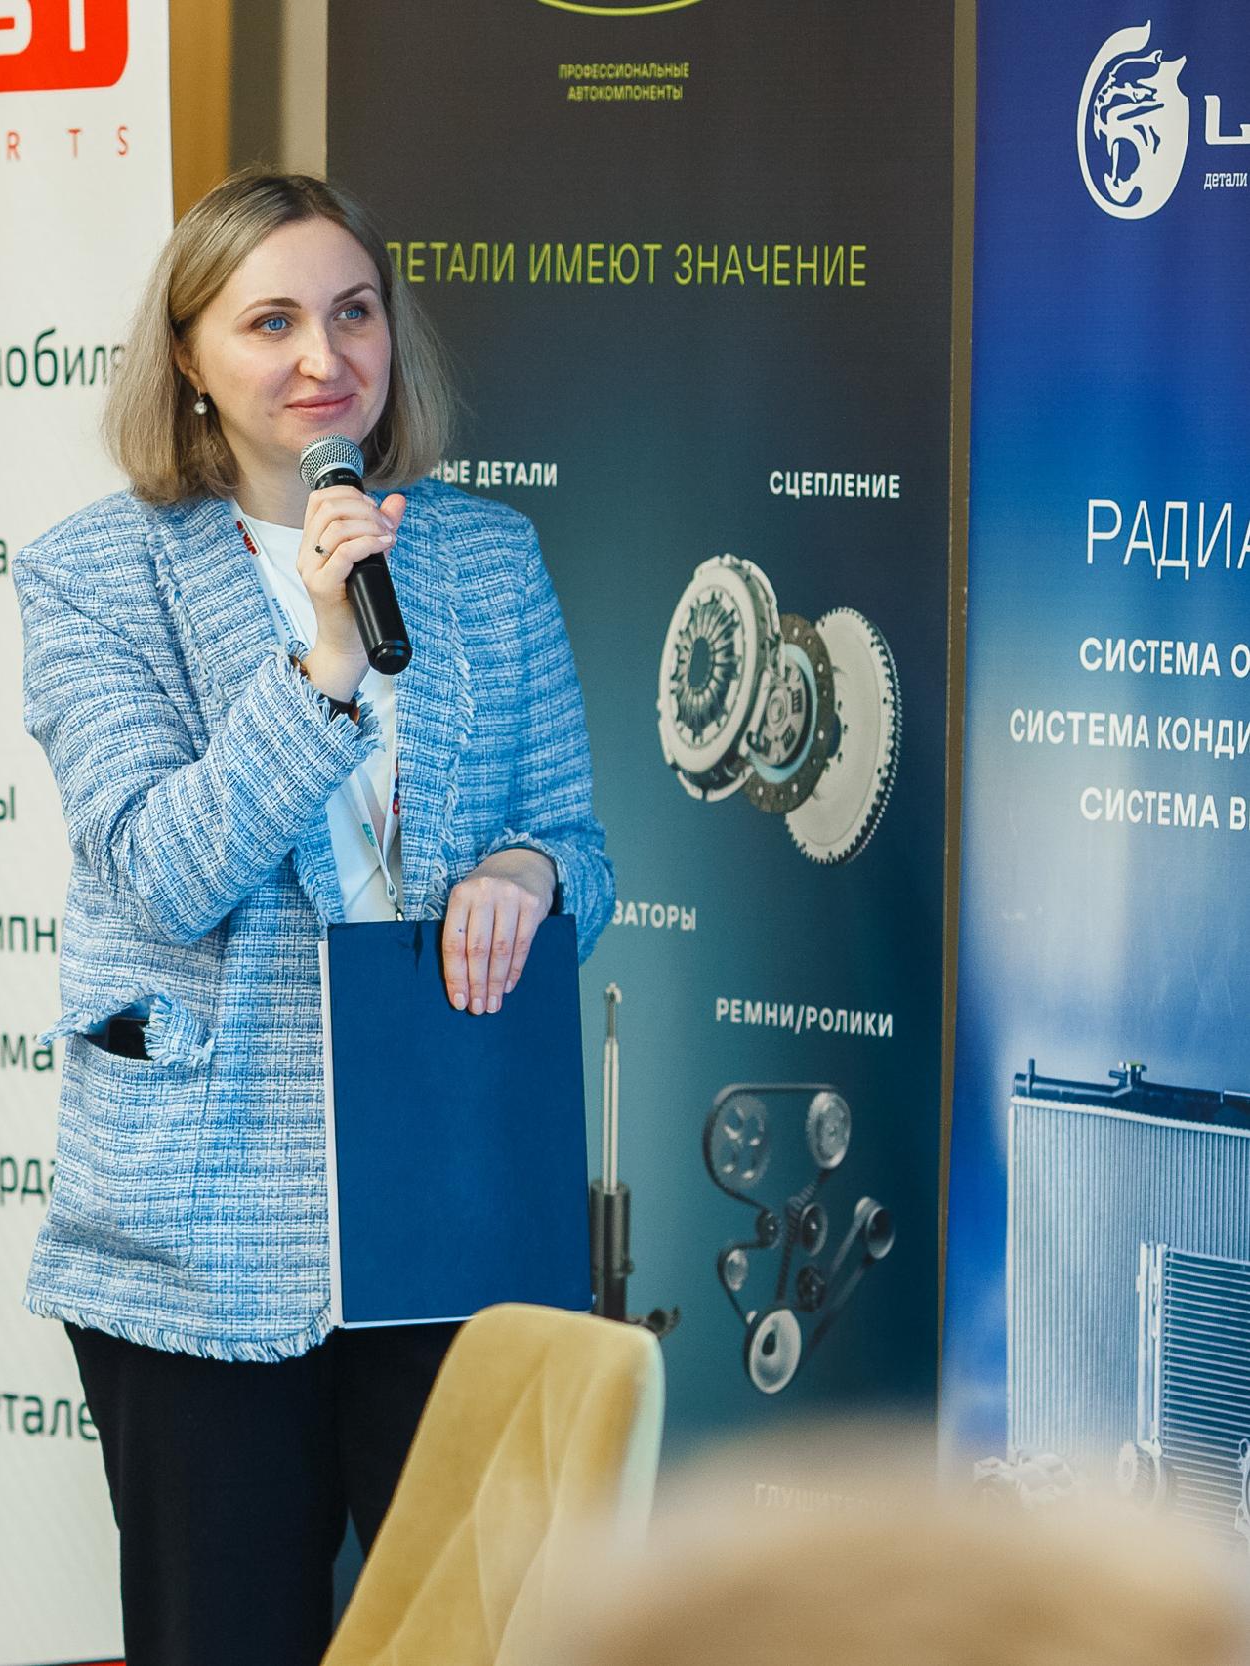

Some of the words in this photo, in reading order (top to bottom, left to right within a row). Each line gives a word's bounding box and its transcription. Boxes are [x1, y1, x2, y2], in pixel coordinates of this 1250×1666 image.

[558, 62, 689, 79] ПРОФЕССИОНАЛЬНЫЕ
[567, 85, 683, 101] АВТОКОМПОНЕНТЫ
[1203, 172, 1248, 190] детали
[529, 242, 662, 285] ИМЕЮТ
[674, 243, 867, 287] ЗНАЧЕНИЕ
[475, 460, 558, 488] ДЕТАЛИ
[769, 470, 900, 499] СЦЕПЛЕНИЕ
[1079, 637, 1221, 678] СИСТЕМА
[1009, 708, 1150, 749] СИСТЕМА
[1079, 786, 1220, 830] СИСТЕМА
[715, 997, 894, 1038] РЕМНИ/РОЛИКИ
